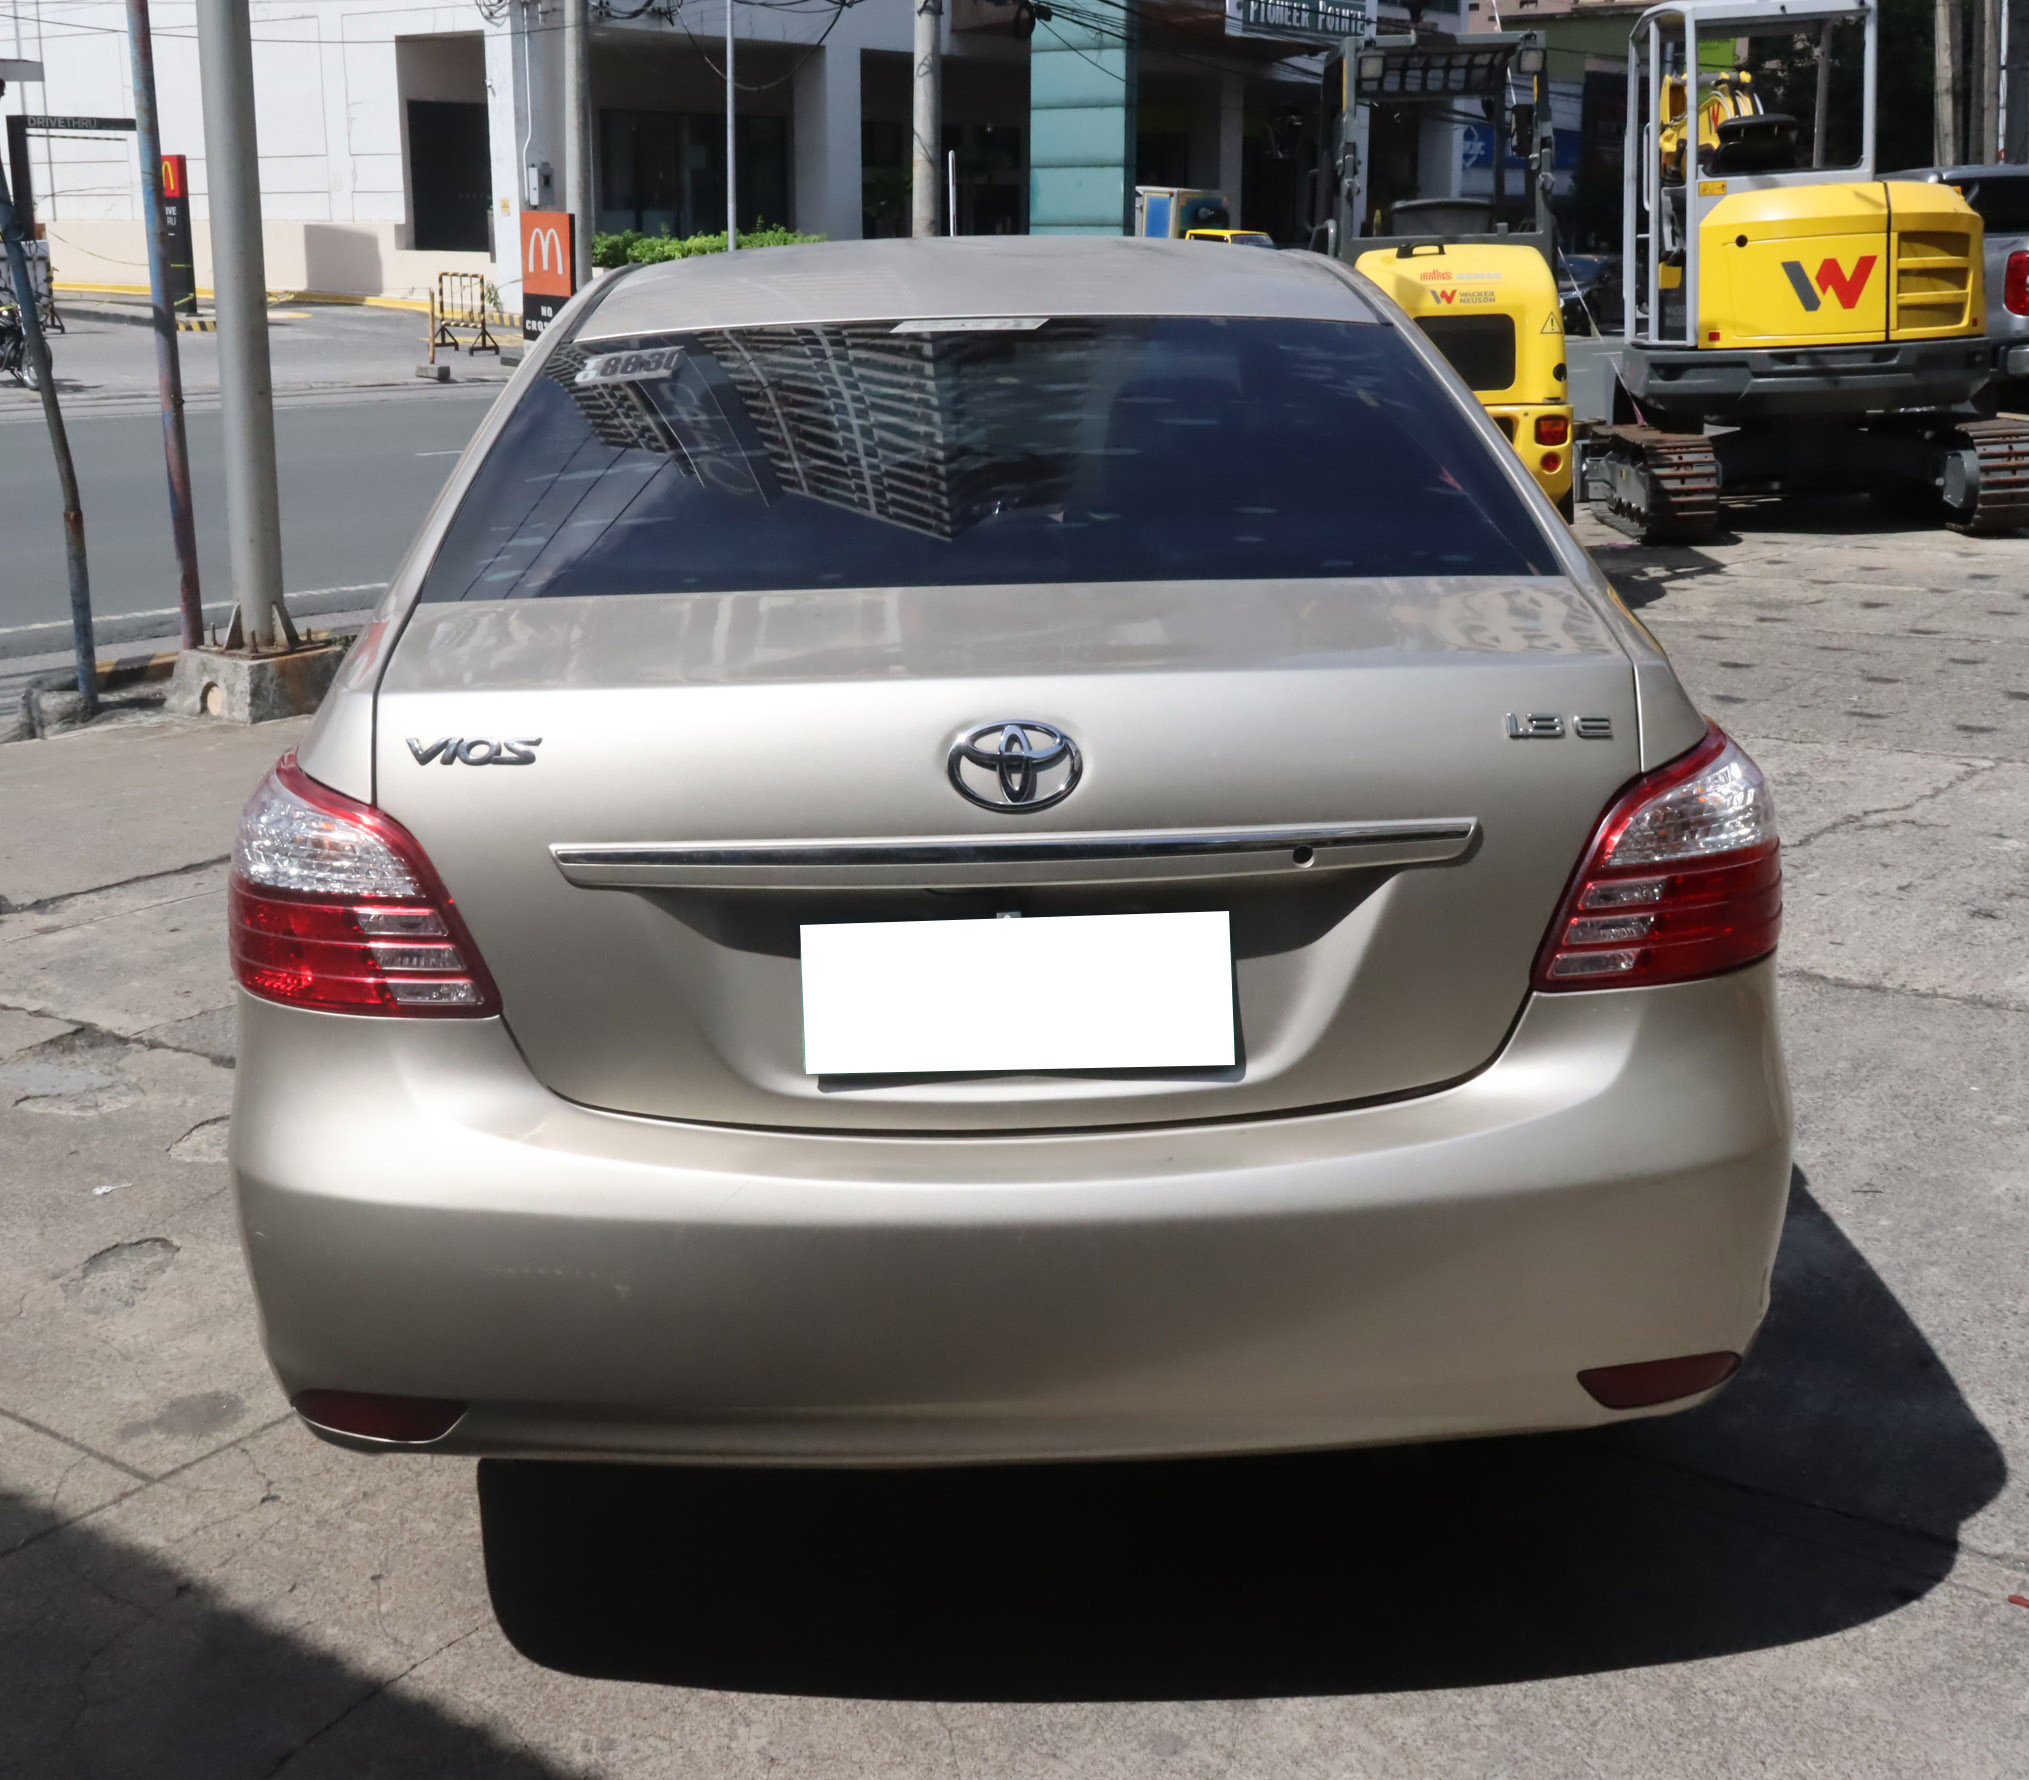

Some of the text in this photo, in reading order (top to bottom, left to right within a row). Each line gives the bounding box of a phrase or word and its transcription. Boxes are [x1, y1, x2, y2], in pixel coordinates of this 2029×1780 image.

[1250, 0, 1366, 34] PIONEER POINTE
[541, 306, 553, 317] NO
[1505, 713, 1614, 740] 1.3 E
[405, 737, 543, 766] VIOS
